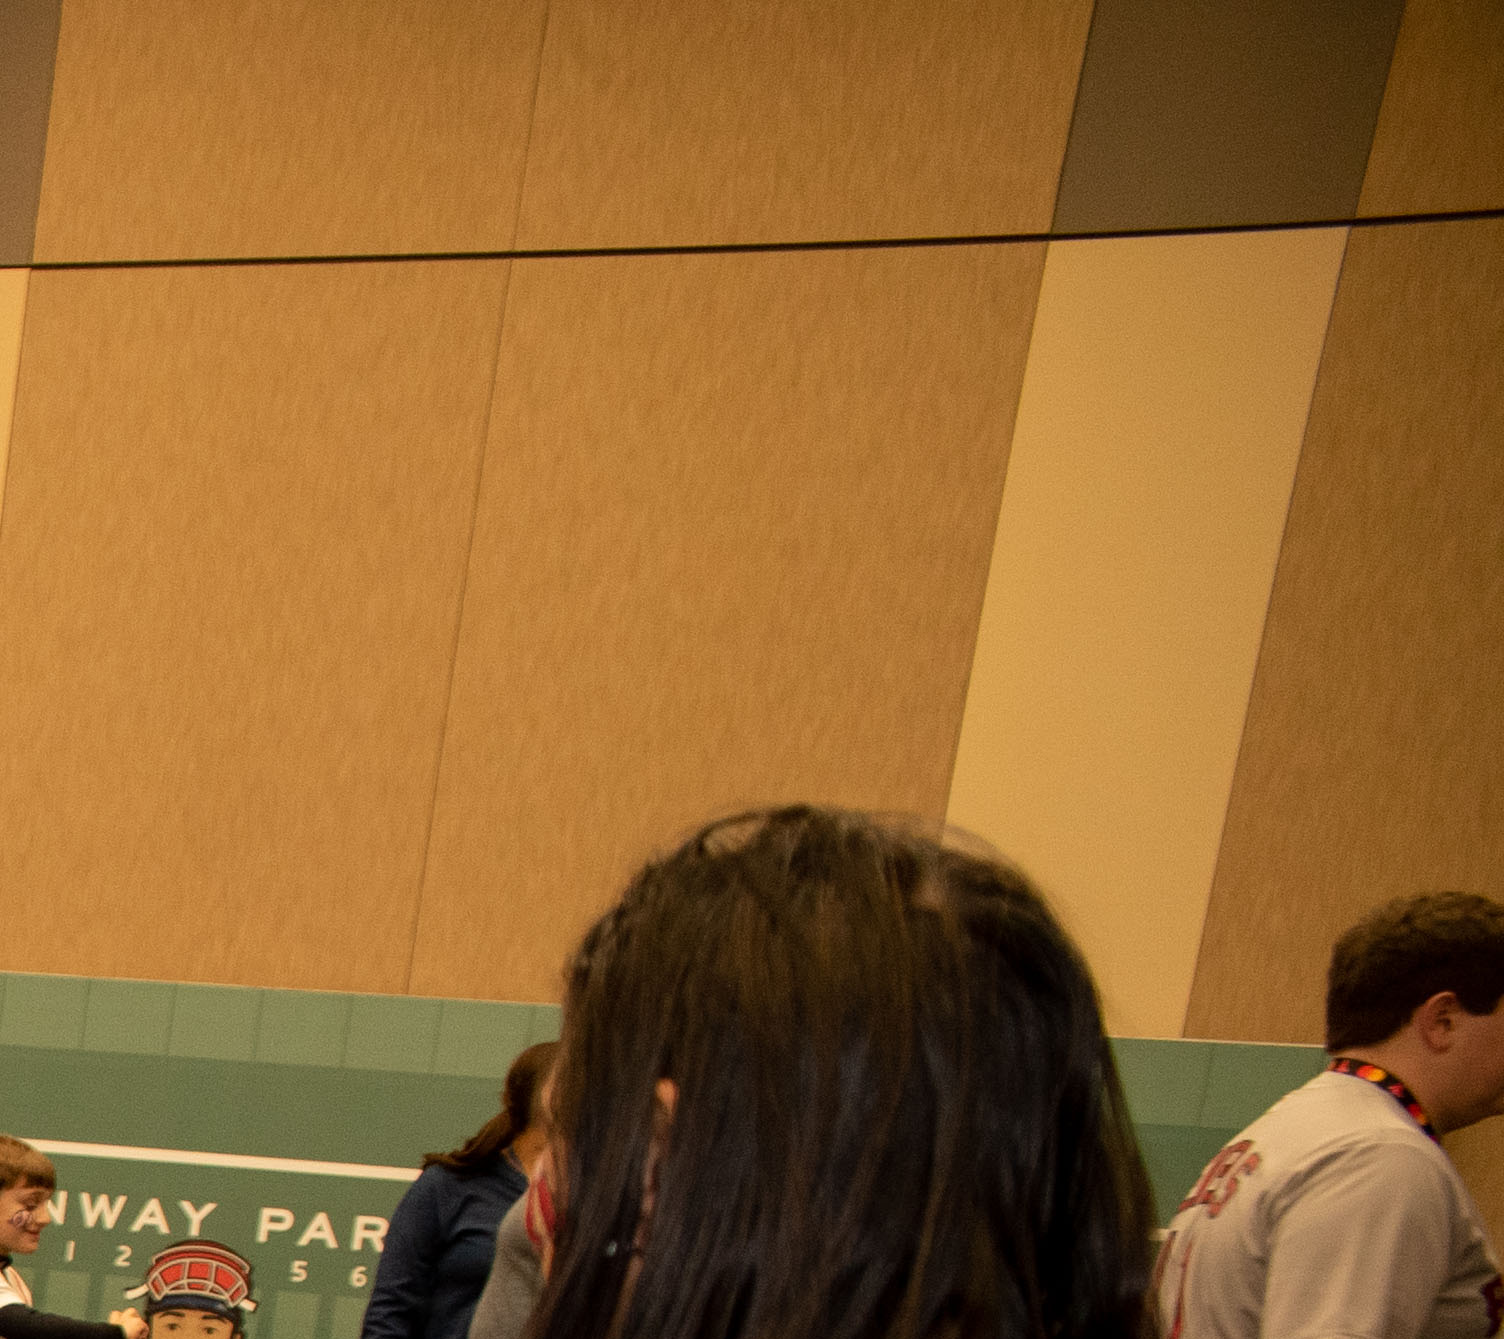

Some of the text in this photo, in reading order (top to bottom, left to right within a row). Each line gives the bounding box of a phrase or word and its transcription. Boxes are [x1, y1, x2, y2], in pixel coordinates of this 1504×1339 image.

[65, 1240, 368, 1288] 1 2 5 6
